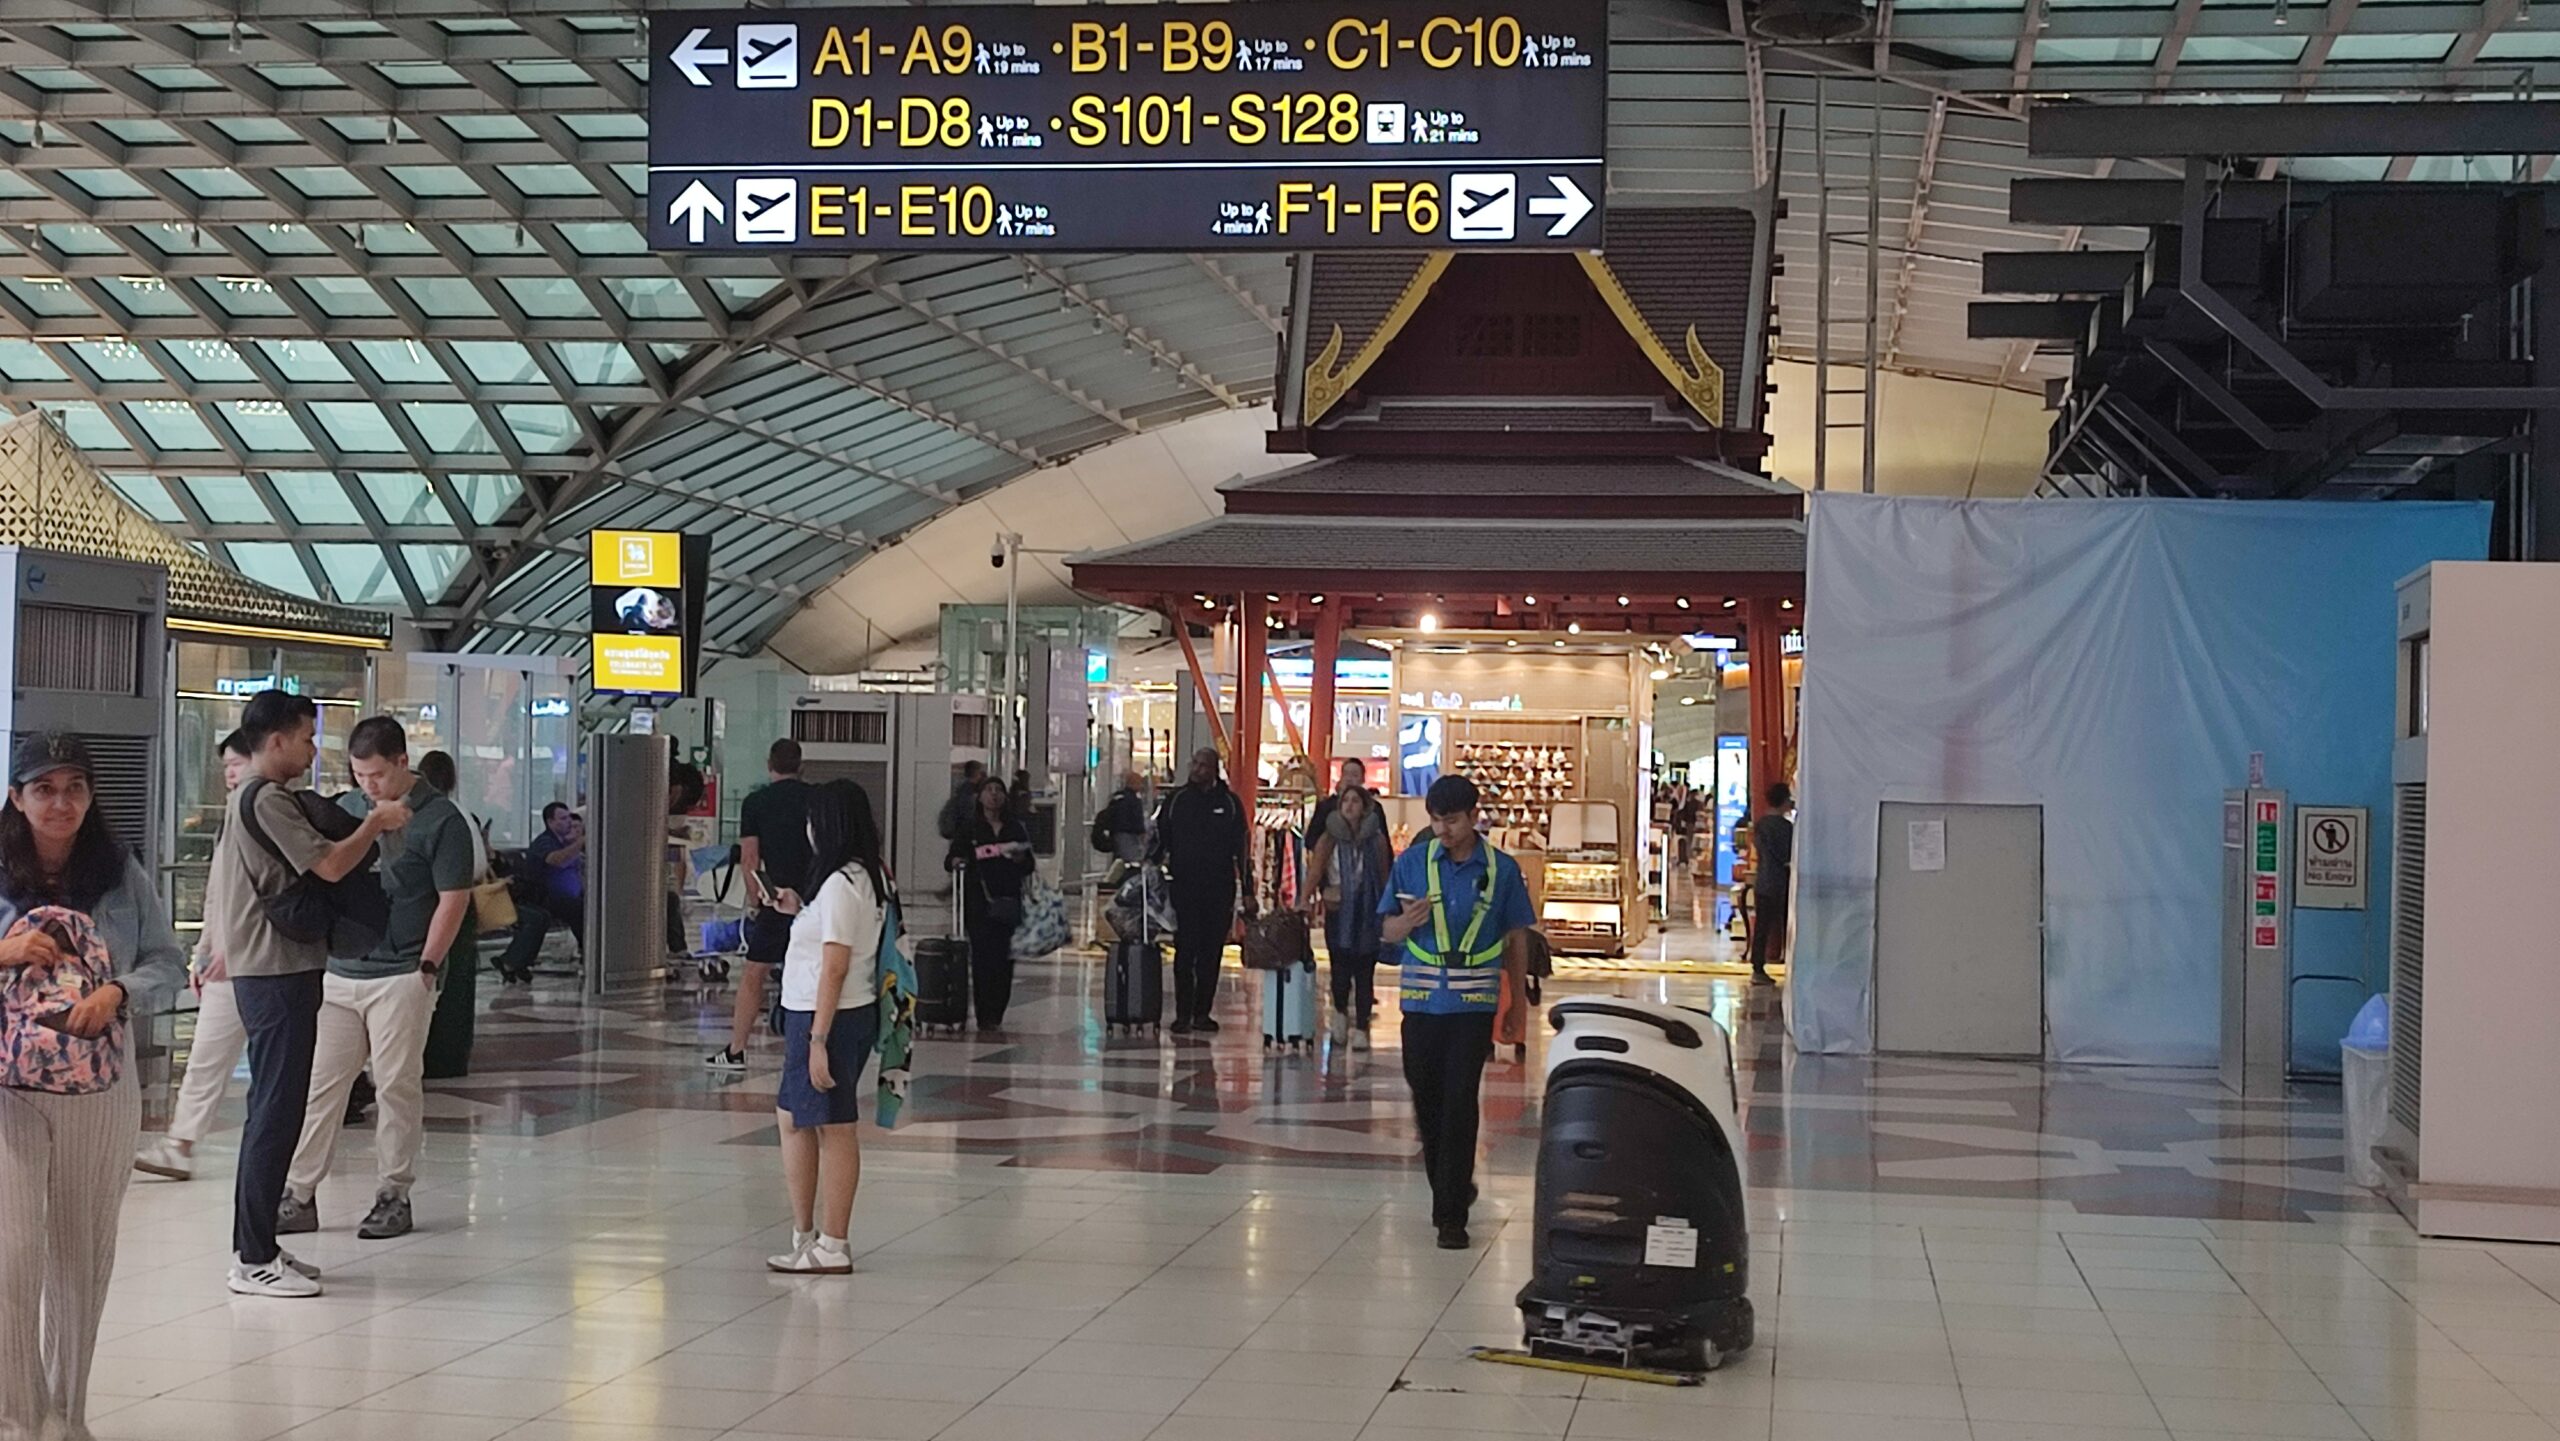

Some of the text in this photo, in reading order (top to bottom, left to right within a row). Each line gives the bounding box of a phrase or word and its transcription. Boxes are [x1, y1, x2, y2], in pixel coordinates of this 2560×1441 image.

[813, 25, 972, 75] A1-A9
[992, 43, 1026, 58] Up to
[1071, 21, 1233, 72] B1-B9
[1254, 39, 1288, 55] Up to
[1327, 16, 1521, 69] C1-C10
[1541, 35, 1576, 51] Up to
[993, 60, 1040, 74] 19 mins
[1255, 56, 1303, 71] 17 mins
[1542, 52, 1591, 67] 19 mins
[811, 97, 971, 147] D1-D8
[996, 115, 1029, 132] Up to
[1069, 93, 1359, 146] S101-S128
[1430, 110, 1464, 127] Up to
[996, 132, 1042, 147] 11 mins
[1429, 128, 1479, 143] 21 mins
[811, 185, 993, 235] E1-E10
[1014, 204, 1048, 221] Up to
[1220, 202, 1254, 219] Up to
[1278, 182, 1439, 234] F1-F6
[1014, 221, 1056, 236] 7 mins
[1211, 220, 1254, 234] 4 mins
[2308, 871, 2353, 884] No Entry
